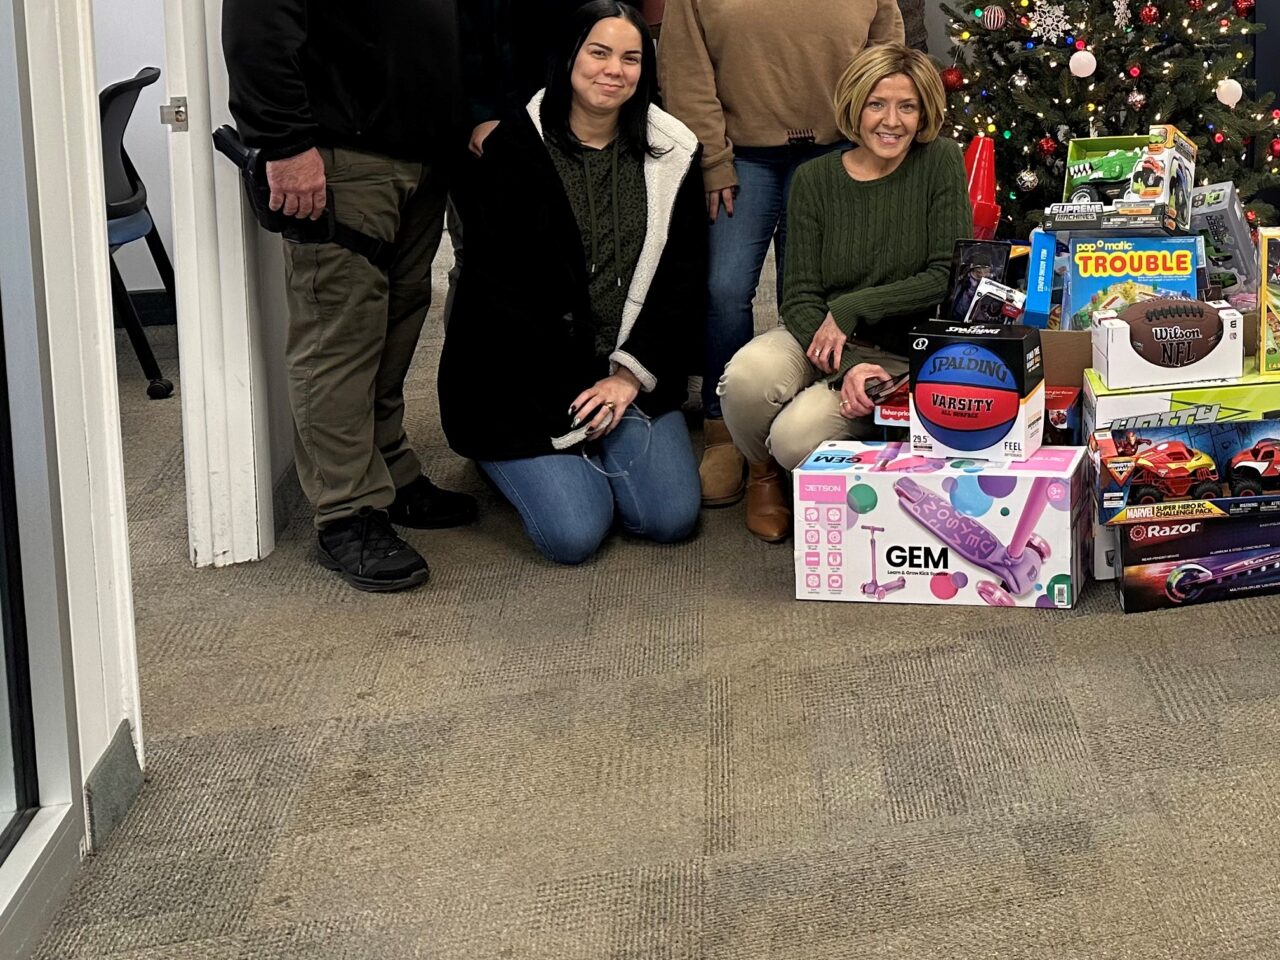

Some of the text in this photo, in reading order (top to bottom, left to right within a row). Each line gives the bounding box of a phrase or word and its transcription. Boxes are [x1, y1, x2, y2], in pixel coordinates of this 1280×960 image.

[1051, 204, 1103, 214] SUPREME
[1055, 213, 1097, 221] MACHINES
[1076, 243, 1097, 253] pop
[1105, 241, 1132, 250] matic
[1077, 252, 1190, 275] TROUBLE
[1153, 326, 1201, 341] Wilson
[1160, 341, 1196, 367] NFL
[929, 356, 1008, 382] SPALDING
[932, 393, 994, 411] VARSITY
[881, 408, 910, 417] fisher-pric
[1004, 442, 1022, 451] FEEL
[804, 484, 841, 492] JETSON
[1050, 487, 1061, 495] 3+
[1126, 506, 1154, 519] MARVEL
[1147, 522, 1201, 538] Razor
[886, 545, 949, 569] GEM
